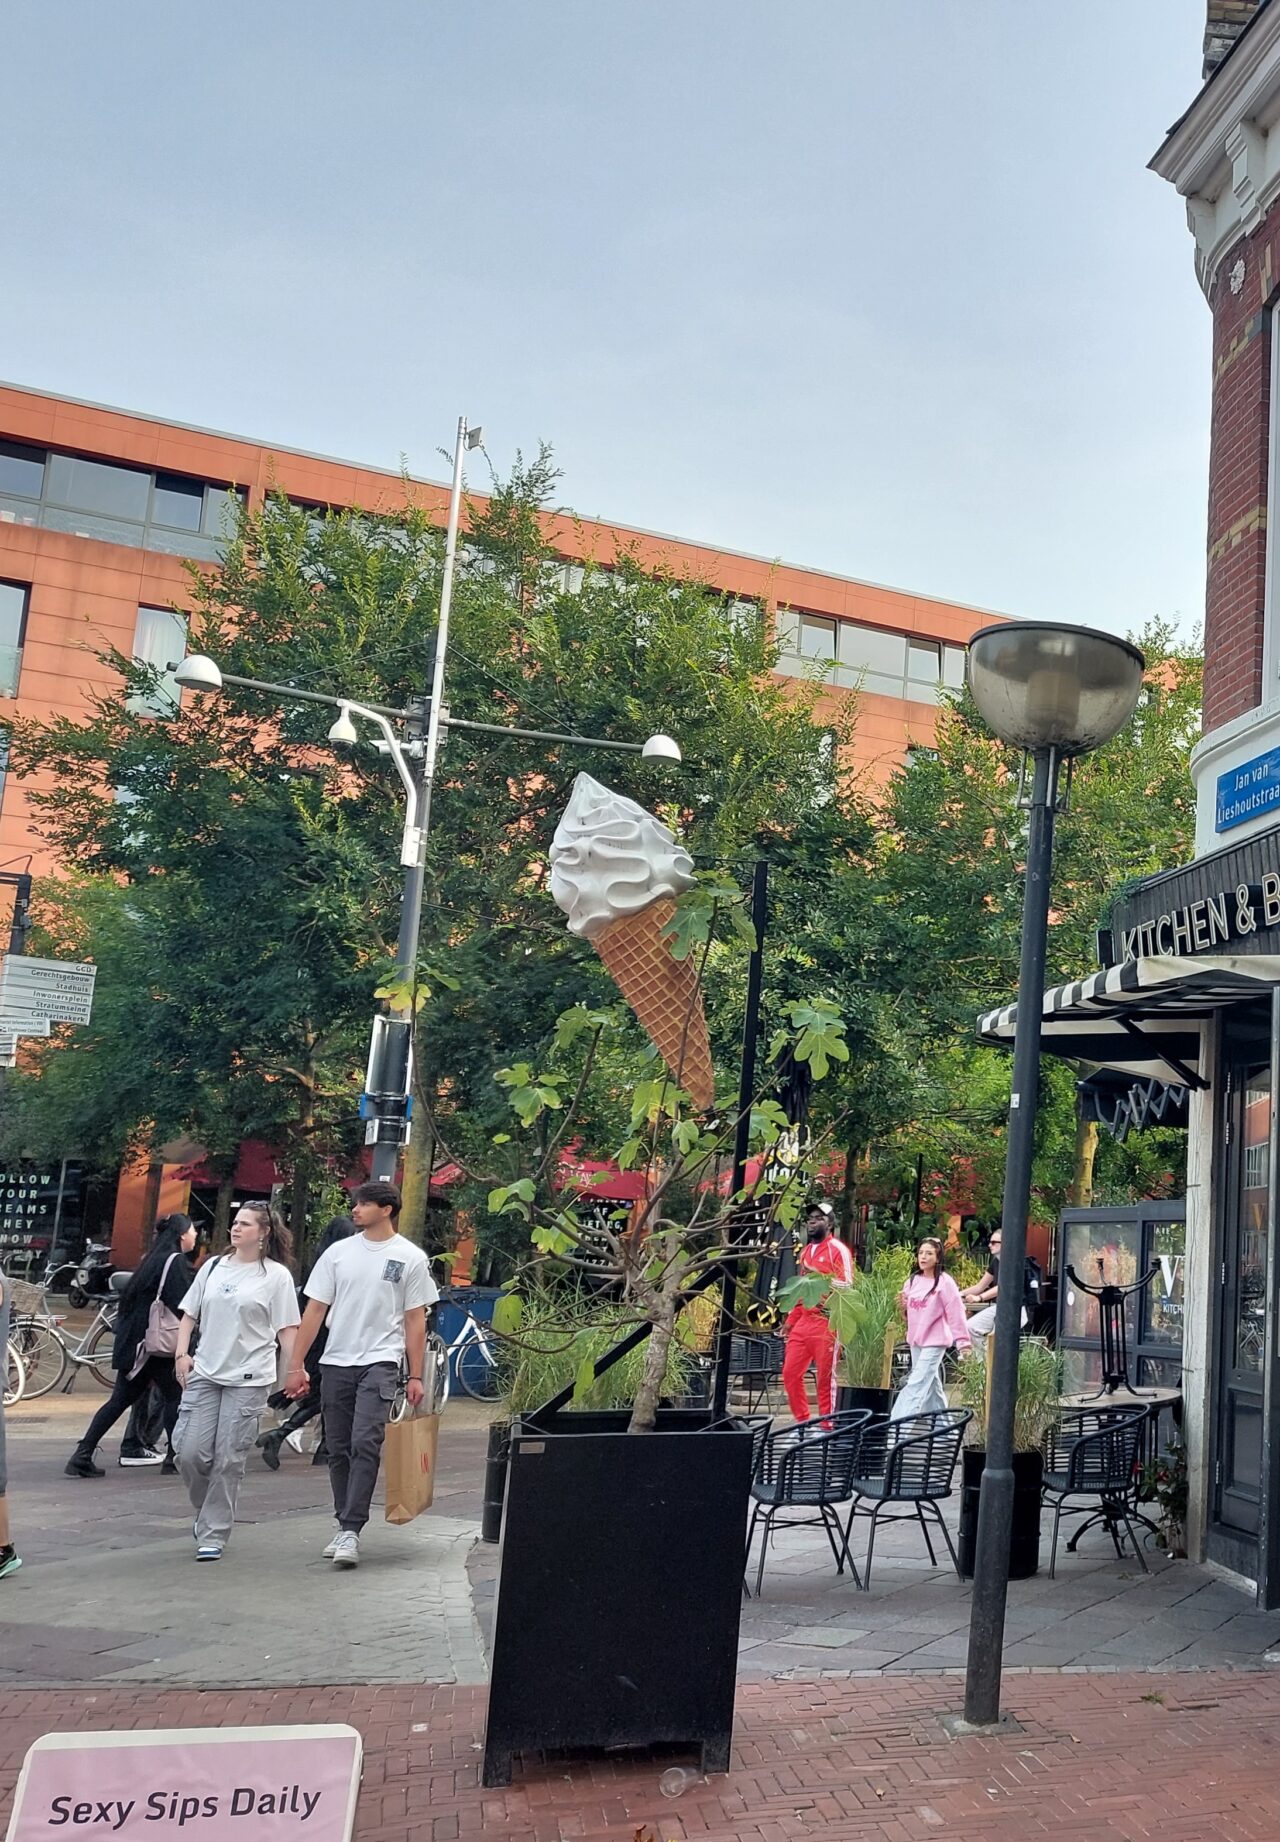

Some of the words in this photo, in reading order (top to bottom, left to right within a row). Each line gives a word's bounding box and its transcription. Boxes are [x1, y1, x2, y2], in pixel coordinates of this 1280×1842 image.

[1234, 774, 1250, 792] Jan
[1252, 763, 1269, 783] van
[1121, 892, 1230, 963] KITCHEN
[1235, 883, 1257, 935] &
[31, 969, 90, 983] Gerechtsgebouw
[55, 982, 88, 993] Stadhuis
[33, 990, 88, 1004] Inwonersplein
[35, 1001, 87, 1014] Stratumseind
[31, 1010, 85, 1023] Catharinakerk
[48, 1796, 136, 1831] Sexy
[145, 1791, 219, 1827] Sips
[229, 1784, 322, 1821] Daily
